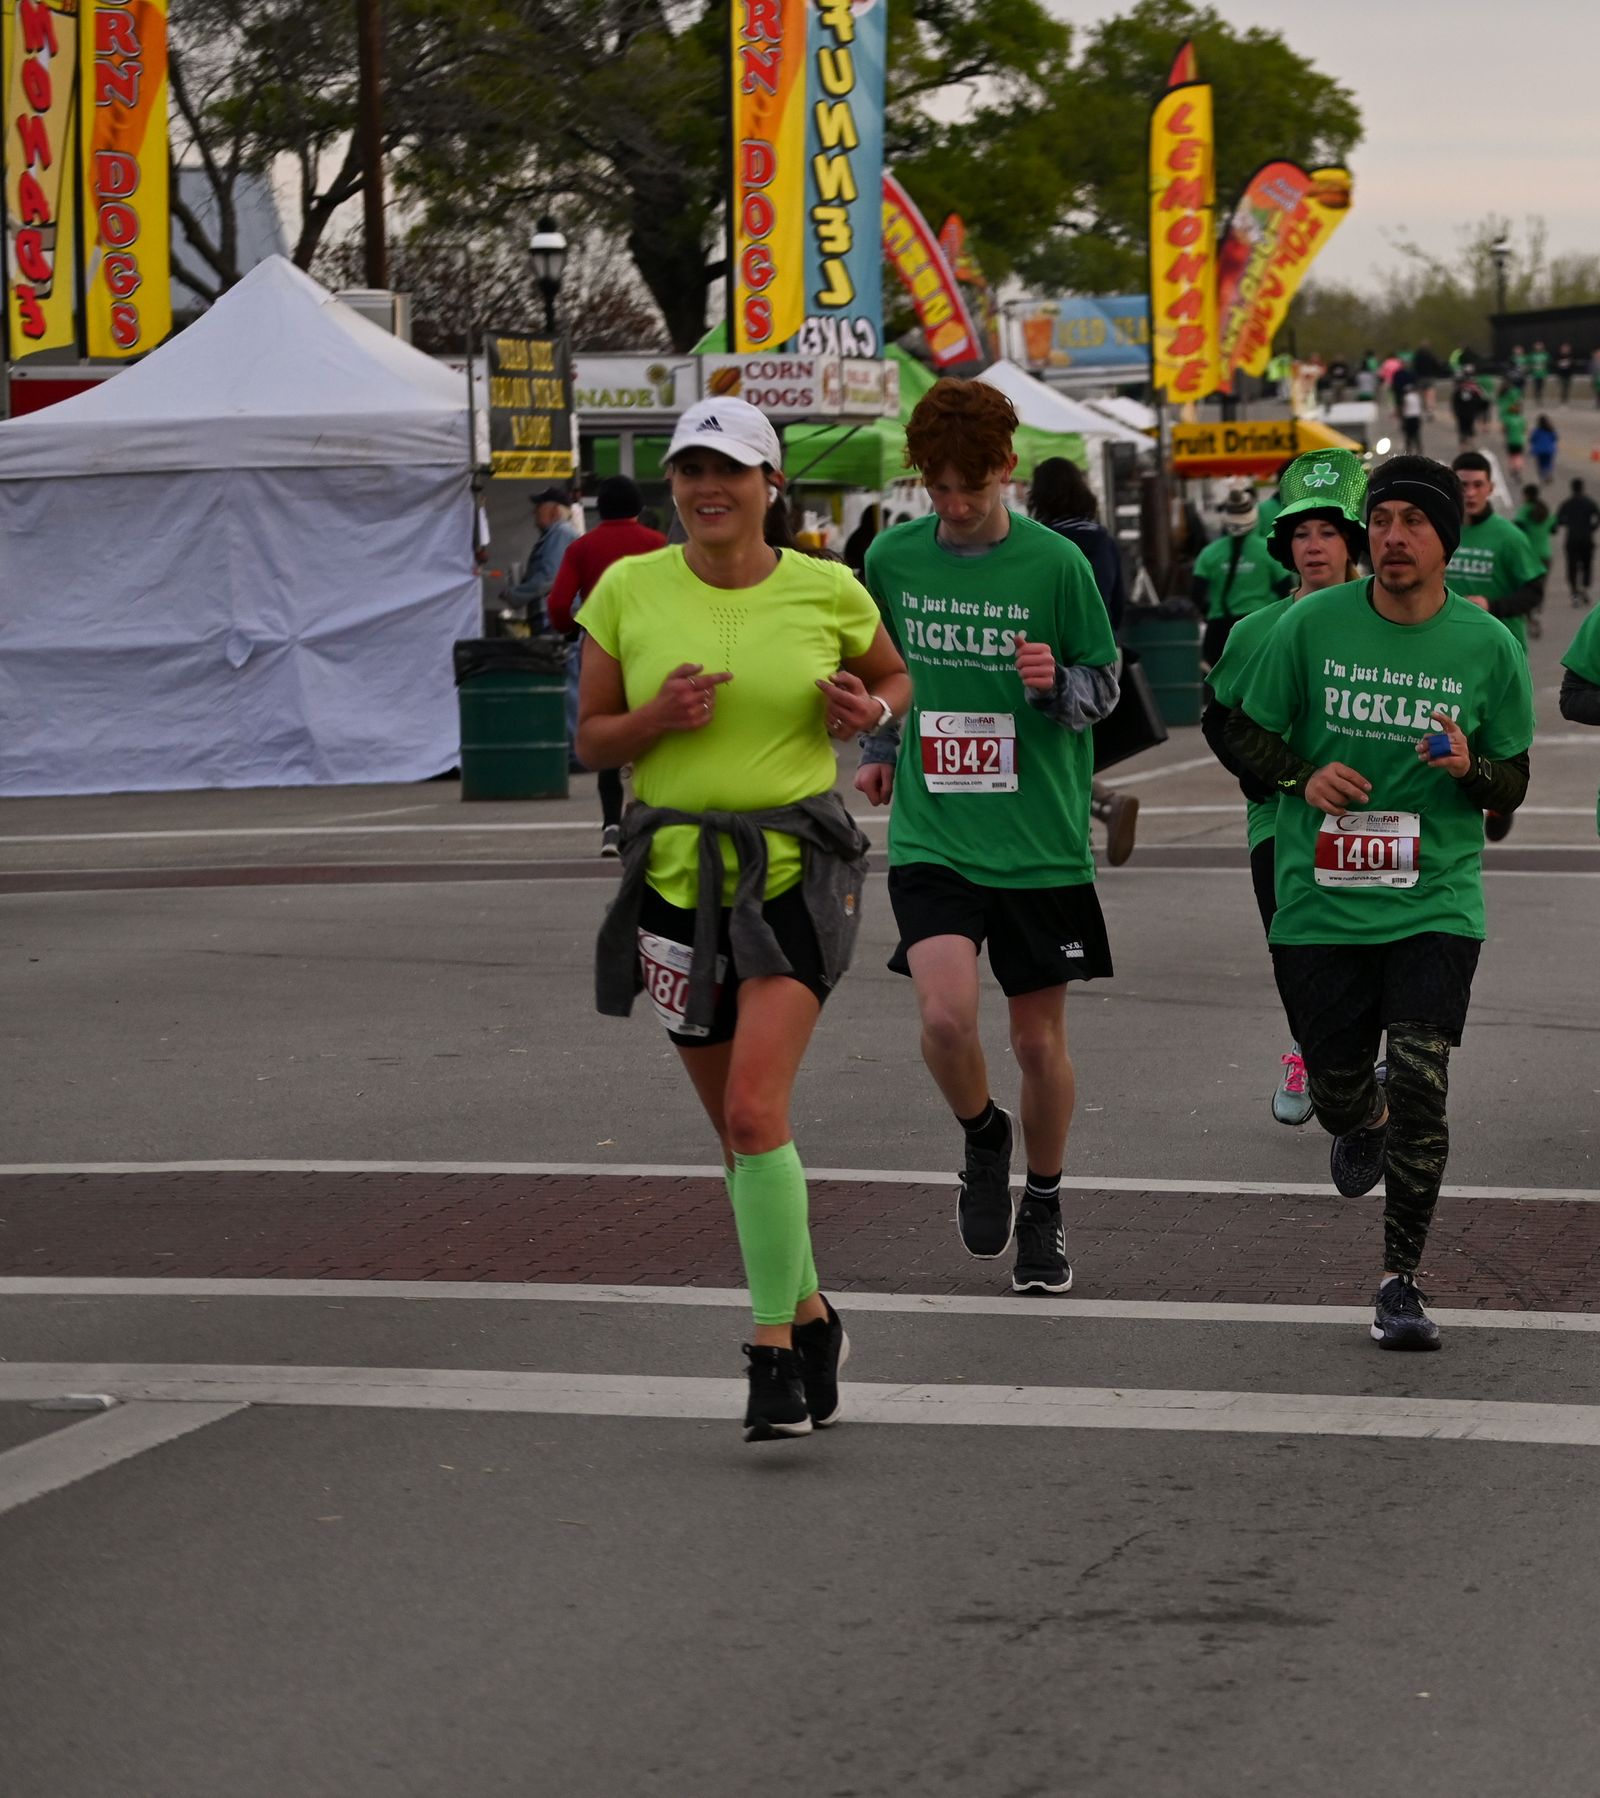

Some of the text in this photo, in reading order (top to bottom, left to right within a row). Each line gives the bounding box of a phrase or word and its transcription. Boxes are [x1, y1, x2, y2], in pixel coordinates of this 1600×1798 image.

[94, 0, 142, 349] RN DOGS
[741, 139, 777, 343] DOGS
[1160, 102, 1208, 393] LEMONADE
[745, 360, 813, 380] CORN
[745, 387, 813, 407] DOGS
[1224, 426, 1298, 453] Drinks
[902, 591, 1030, 620] I'm just here for the
[1323, 658, 1463, 695] I'm just here for the
[1324, 687, 1461, 733] PICKLES!
[933, 739, 1000, 773] 1942
[1366, 814, 1400, 823] RunFAR
[1333, 836, 1398, 870] 1401
